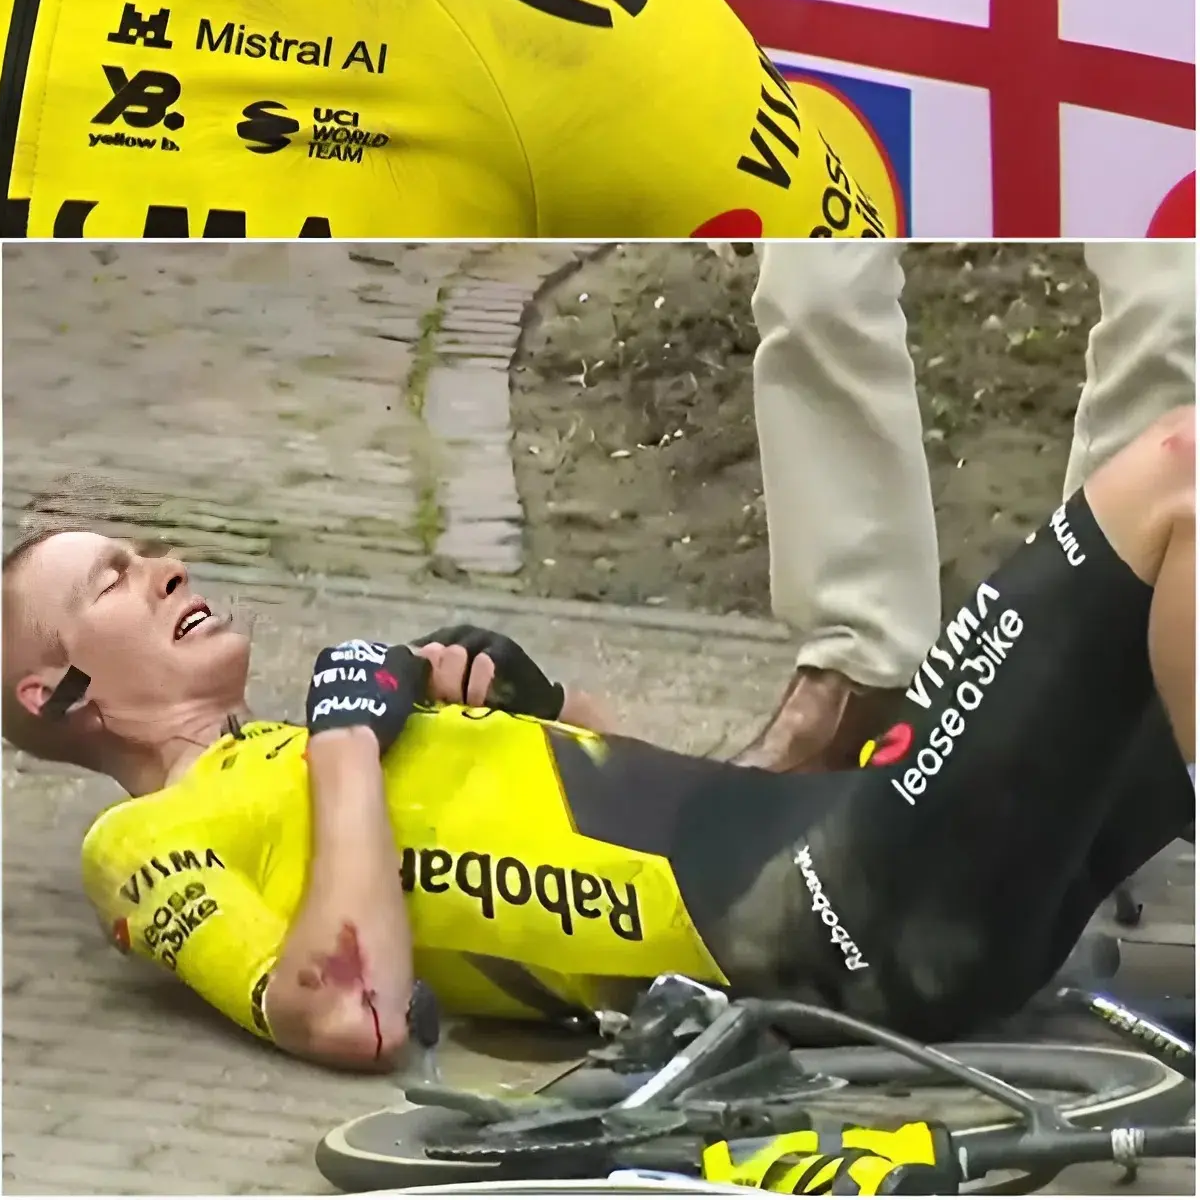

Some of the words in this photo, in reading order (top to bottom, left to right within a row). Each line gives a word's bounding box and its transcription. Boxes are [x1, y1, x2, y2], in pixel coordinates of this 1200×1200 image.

[195, 18, 333, 69] Mistral
[341, 40, 389, 75] AI
[312, 124, 390, 148] WORLD
[313, 107, 359, 127] UCI
[307, 140, 364, 164] TEAM
[904, 582, 1001, 709] VISMA
[891, 708, 966, 806] lease
[119, 848, 226, 904] VISMA
